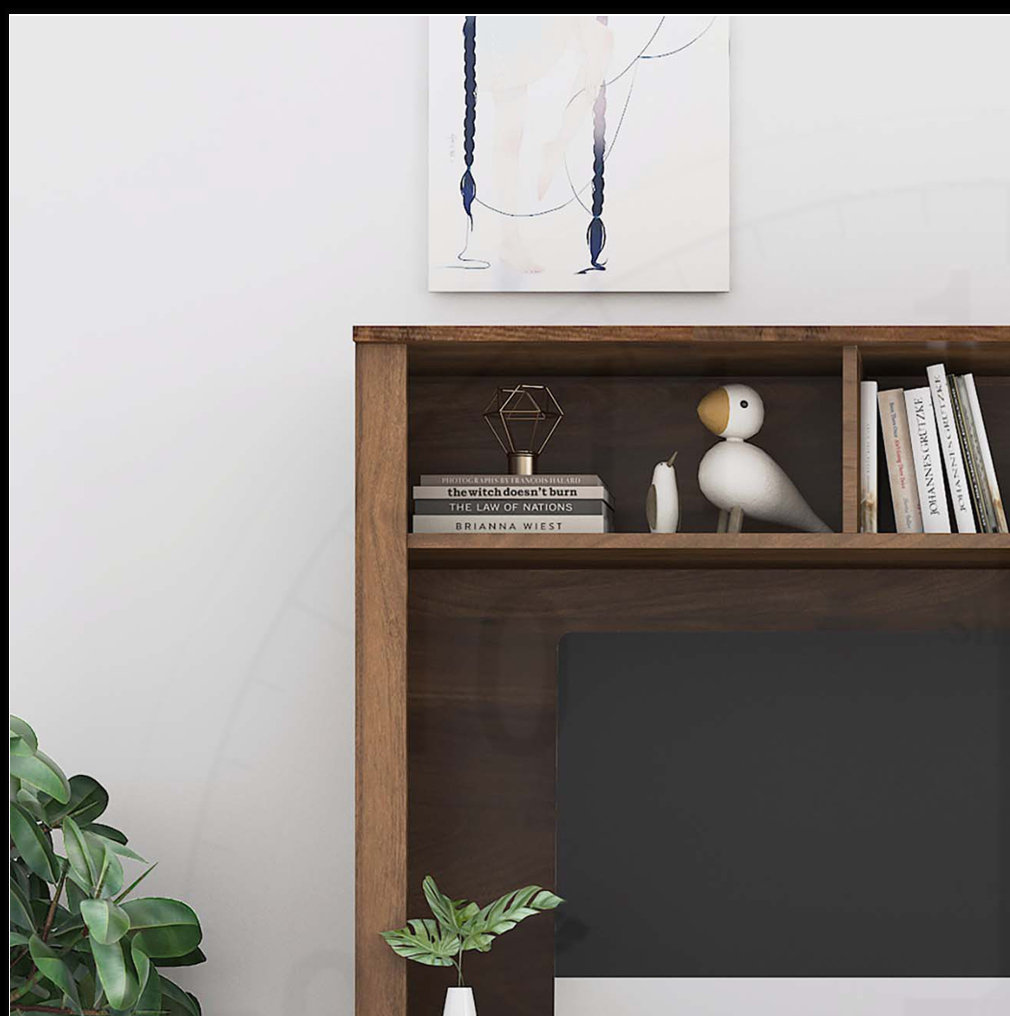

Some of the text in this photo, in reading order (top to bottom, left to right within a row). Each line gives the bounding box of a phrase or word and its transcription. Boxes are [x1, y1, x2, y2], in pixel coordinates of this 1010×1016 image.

[449, 503, 573, 512] THE LAW OF NATIONS
[455, 522, 563, 531] BRIANNA WIEST
